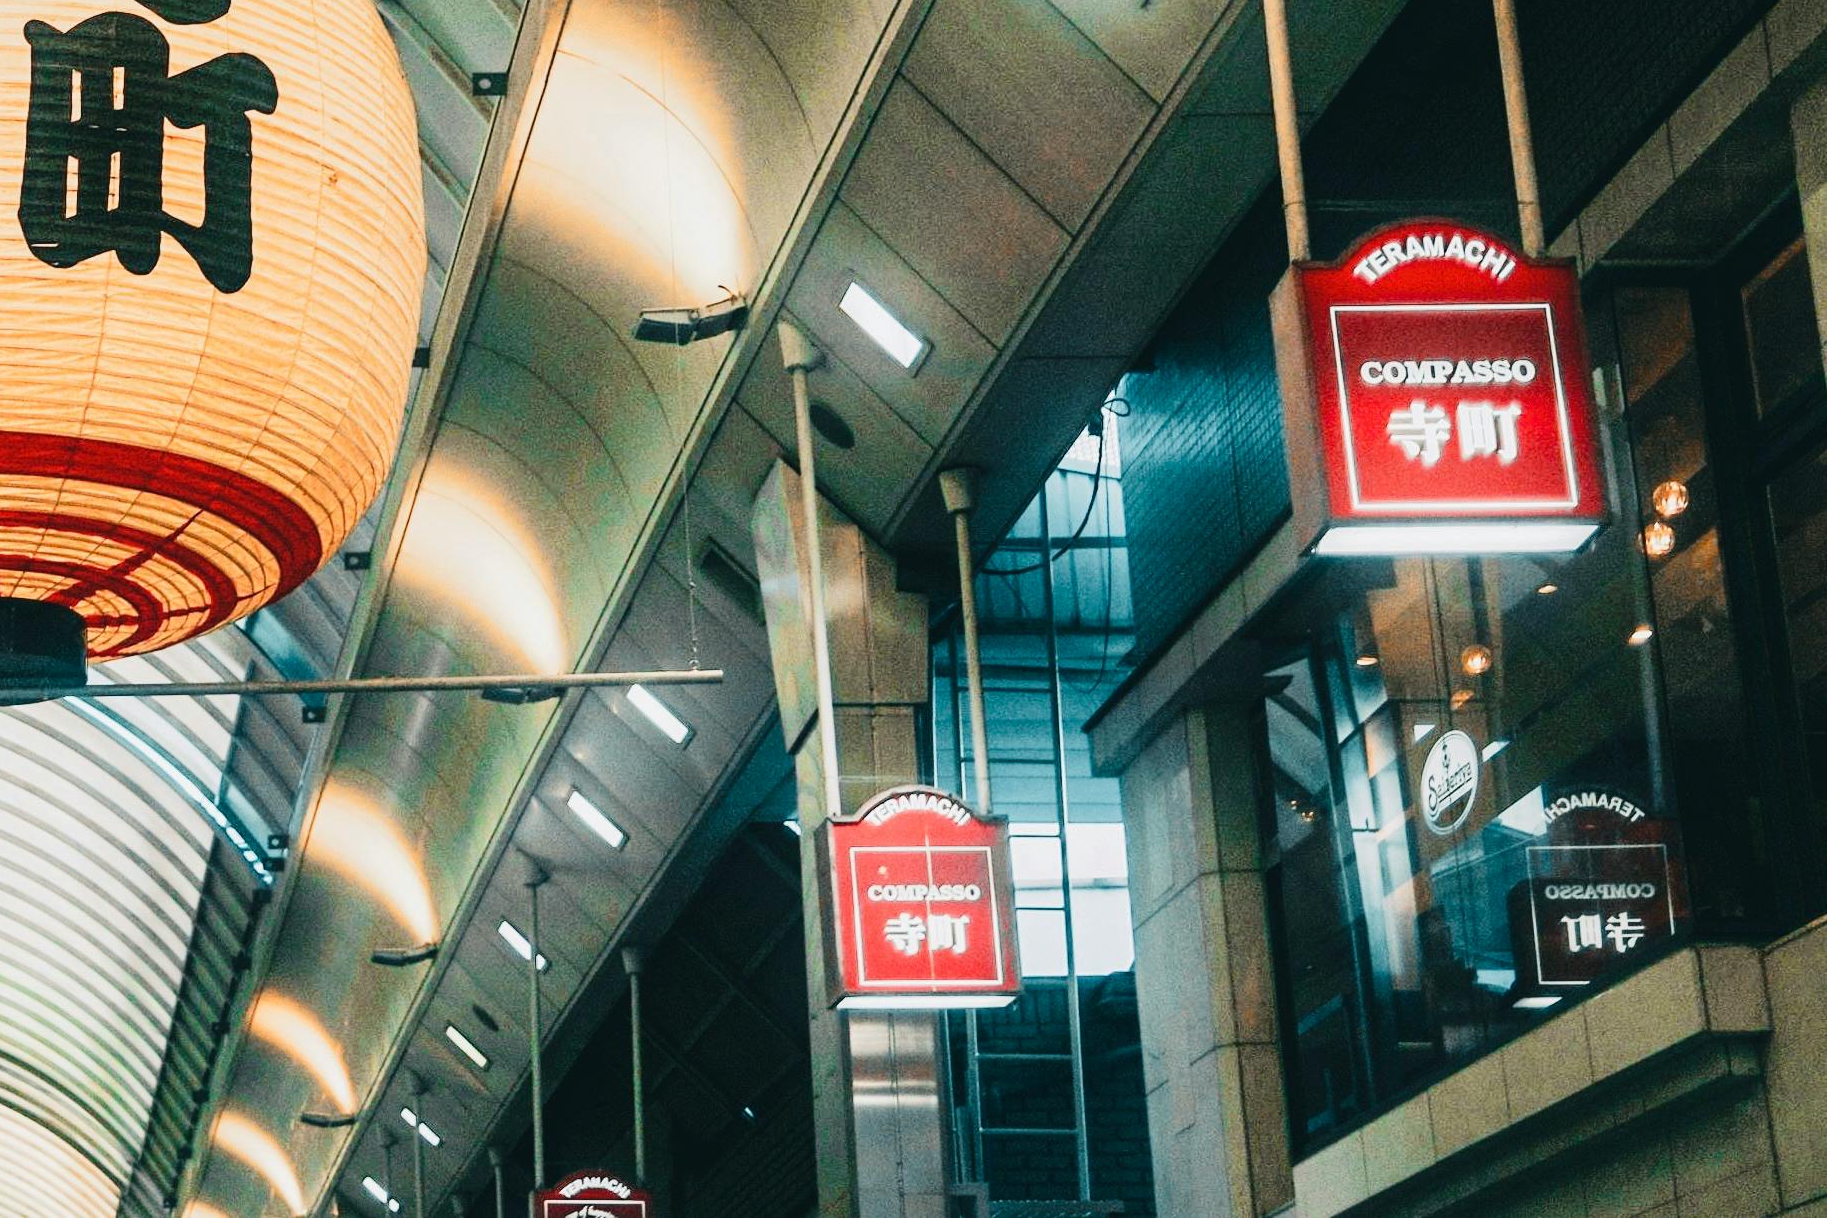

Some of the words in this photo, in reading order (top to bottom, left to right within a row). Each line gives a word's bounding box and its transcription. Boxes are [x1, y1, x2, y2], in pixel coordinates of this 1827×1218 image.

[1353, 233, 1517, 284] TERAMACHI
[1360, 359, 1536, 386] COMPASSO
[1387, 399, 1523, 466] 寺町
[864, 793, 971, 827] TERAMACHI
[867, 884, 982, 902] COMPASSO
[883, 912, 971, 955] 寺町
[558, 1176, 631, 1199] TERAMACHI
